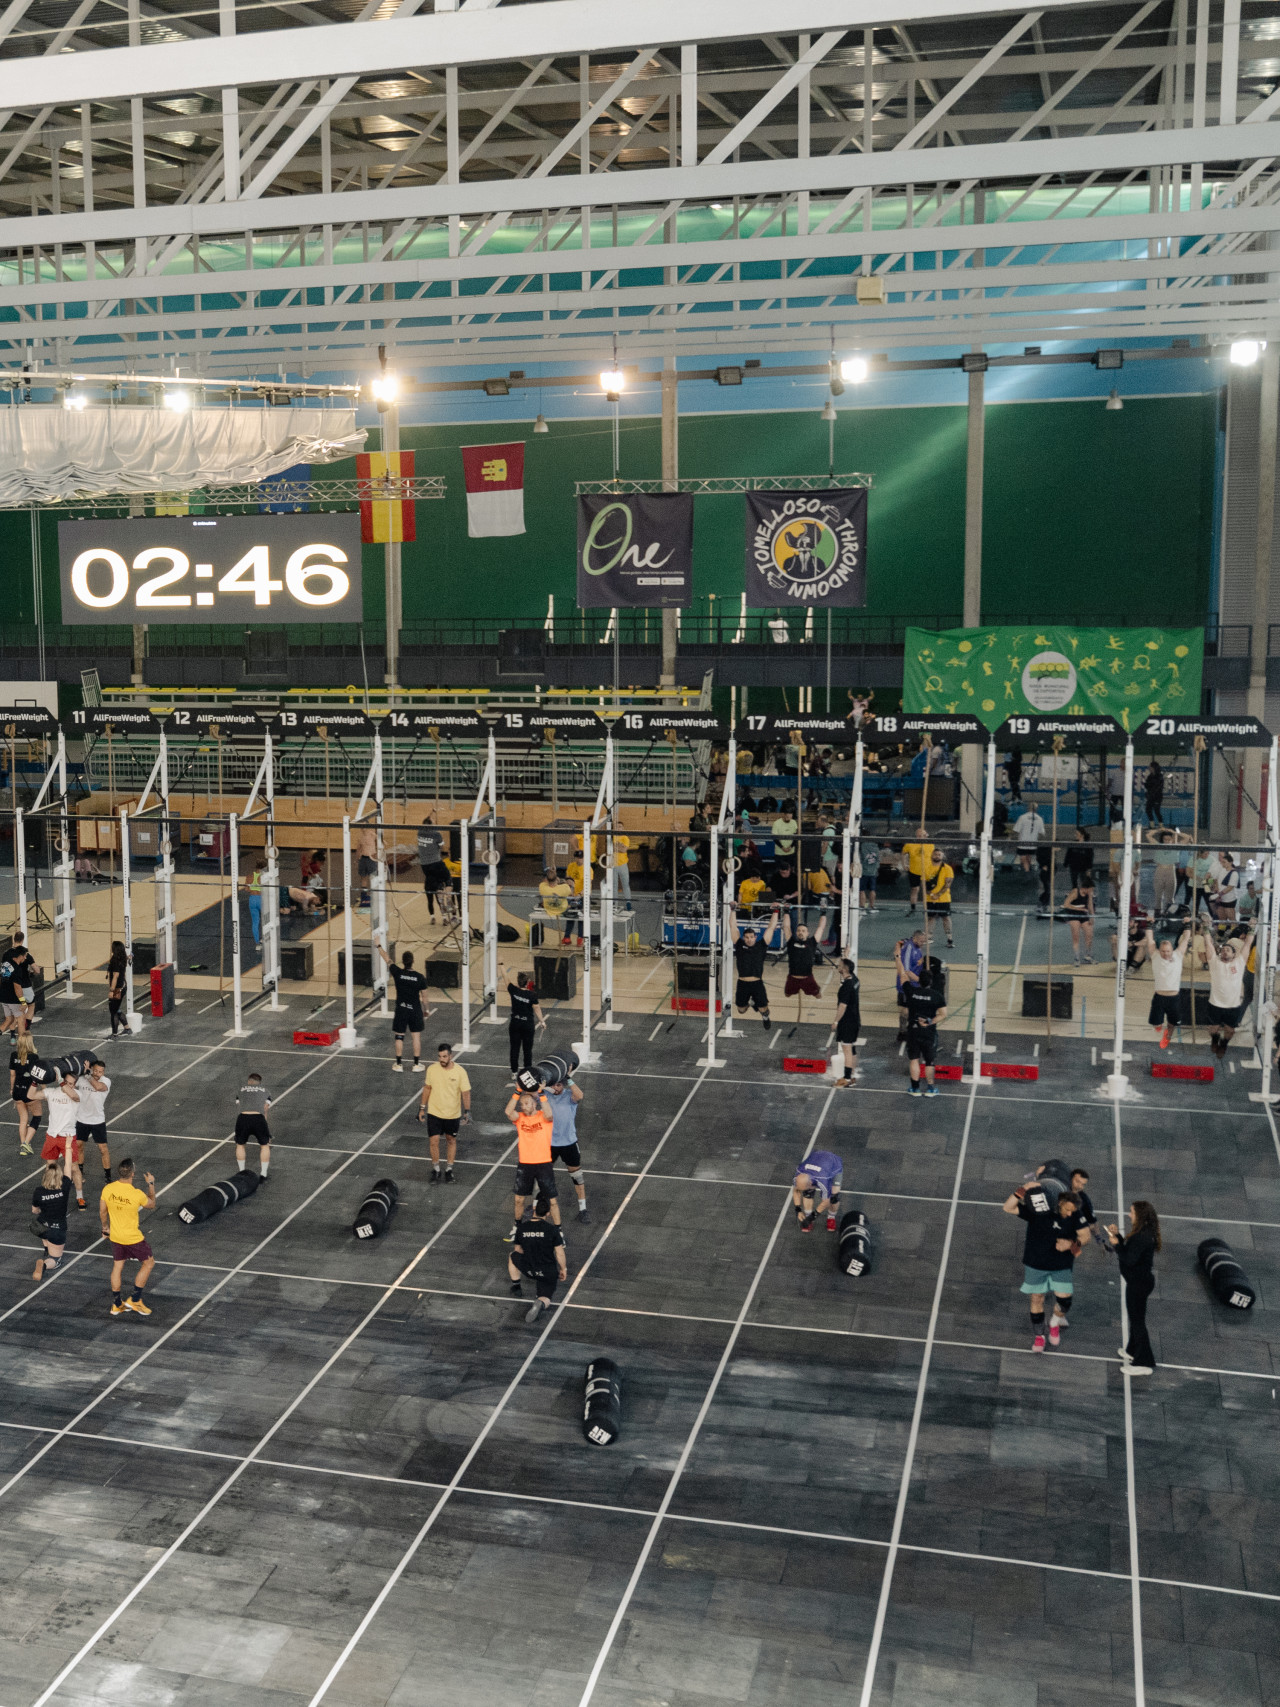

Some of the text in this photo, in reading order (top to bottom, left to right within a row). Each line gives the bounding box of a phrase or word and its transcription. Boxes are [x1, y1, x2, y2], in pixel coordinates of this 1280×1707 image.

[583, 502, 675, 575] One
[754, 498, 859, 600] TOMELLOSO THROWDOWN
[71, 543, 350, 608] 02:46
[73, 712, 150, 723] 11 AllFreeWeight
[174, 713, 255, 724] 12 AllFreeWeight
[279, 714, 364, 725] 13 AllFreeWeight
[390, 715, 478, 726] 14 AllFreeWeight
[504, 715, 596, 727] 15 AllFreeWeight
[623, 715, 718, 729] 16 AllFreeWeight
[747, 716, 845, 730] 17 AllFreeWeight
[876, 717, 977, 732] 18 AllFreeWeight
[1008, 719, 1114, 734] 19 AllFreeWeight
[1146, 719, 1258, 735] 20 AllFreeWeight
[31, 1065, 46, 1079] AFW
[41, 1192, 64, 1201] JUDGE
[588, 1425, 612, 1444] AFW
